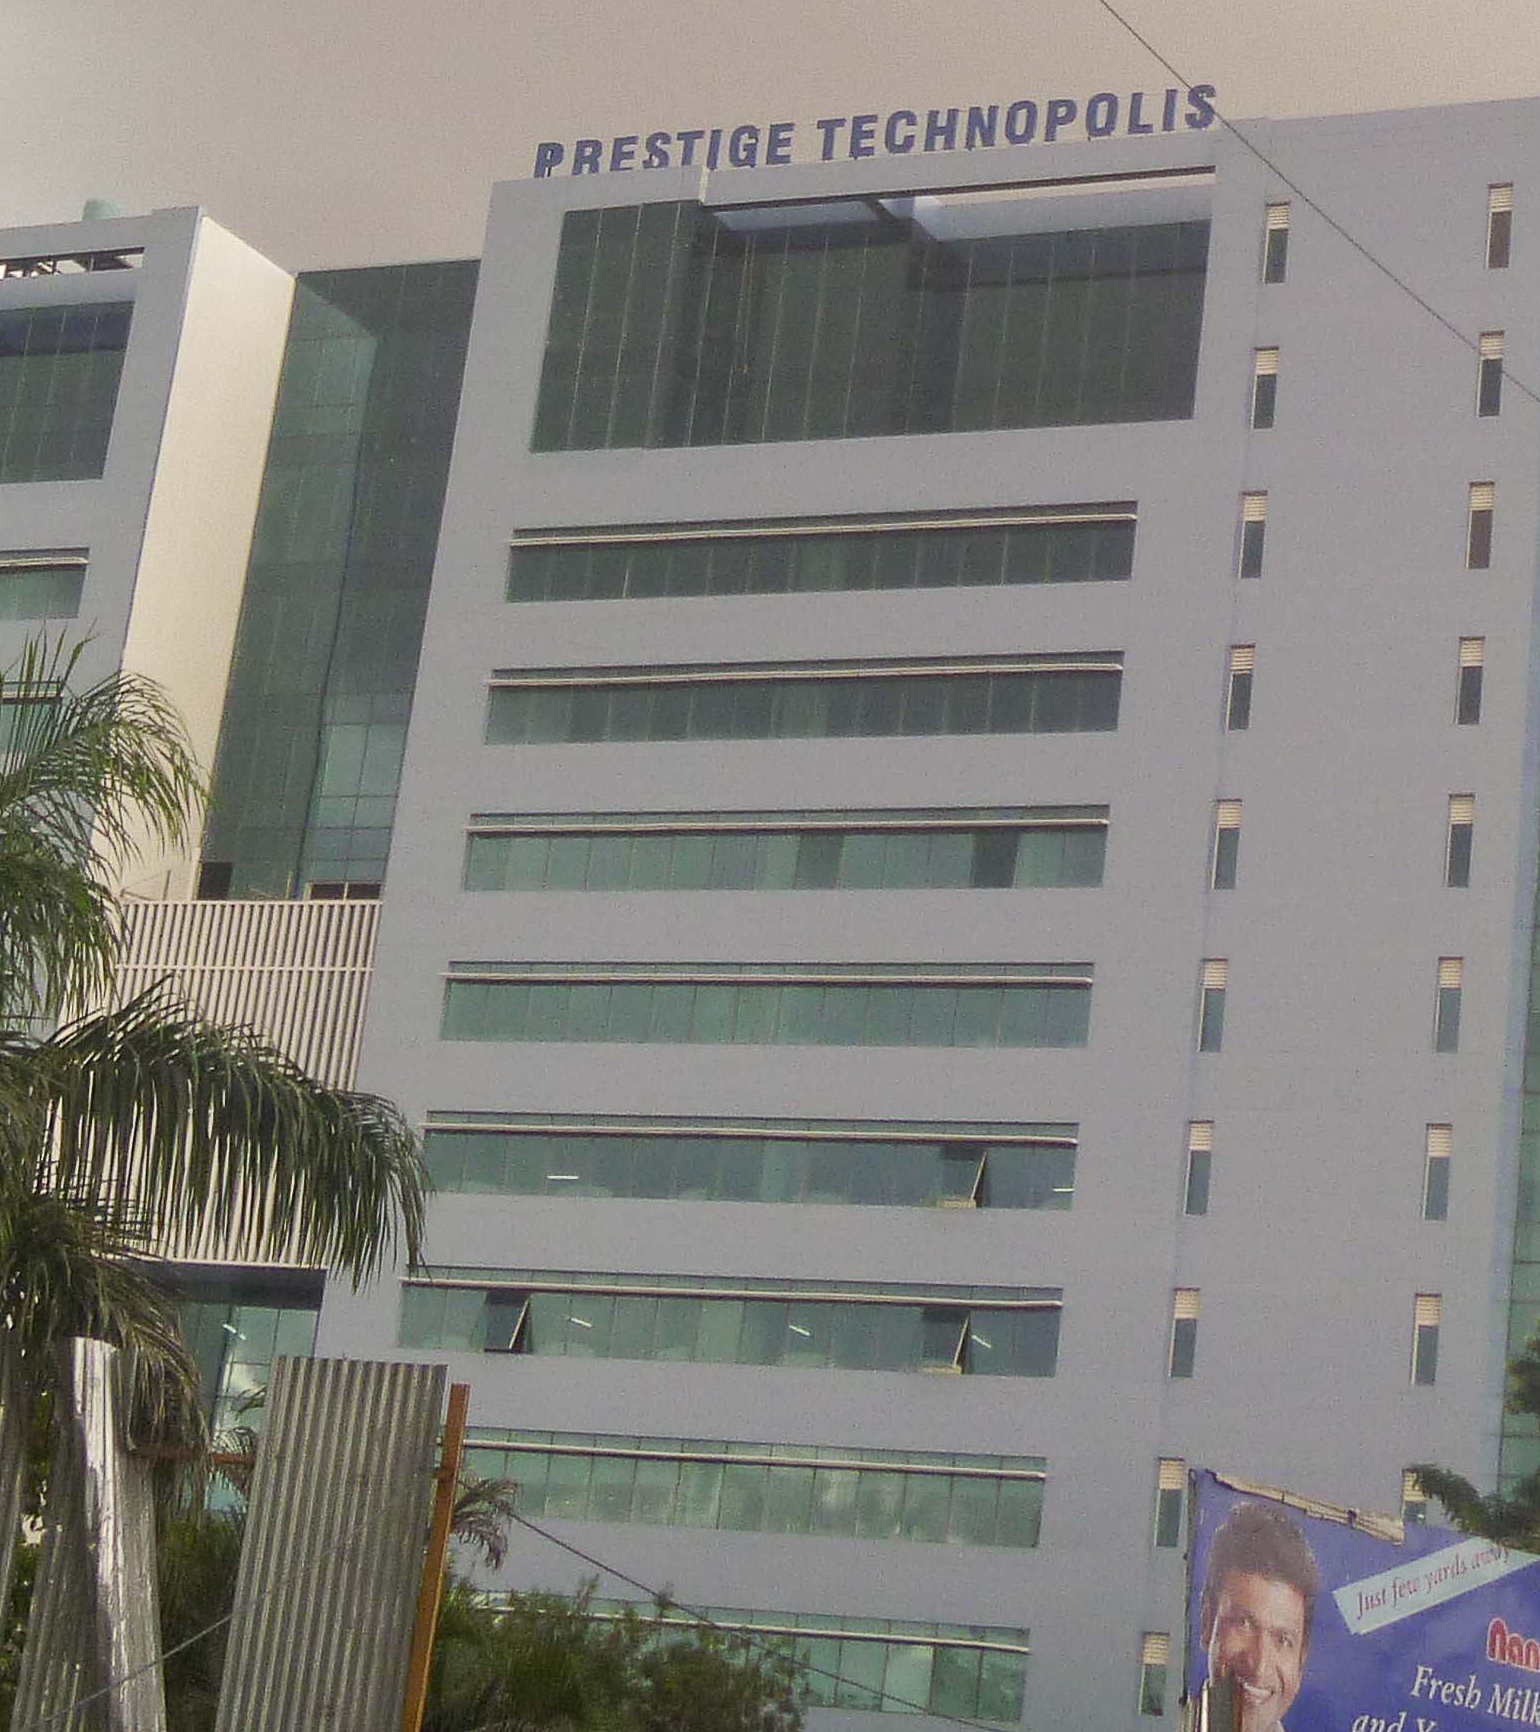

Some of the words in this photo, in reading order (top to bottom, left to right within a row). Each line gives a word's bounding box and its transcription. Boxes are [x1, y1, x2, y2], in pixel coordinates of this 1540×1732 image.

[533, 122, 796, 179] PRESTIGE
[816, 84, 1218, 162] TECHNOPOLIS
[1357, 1591, 1388, 1620] Just
[1391, 1576, 1419, 1608] few
[1424, 1553, 1468, 1594] yards
[1411, 1665, 1483, 1710] Fresh
